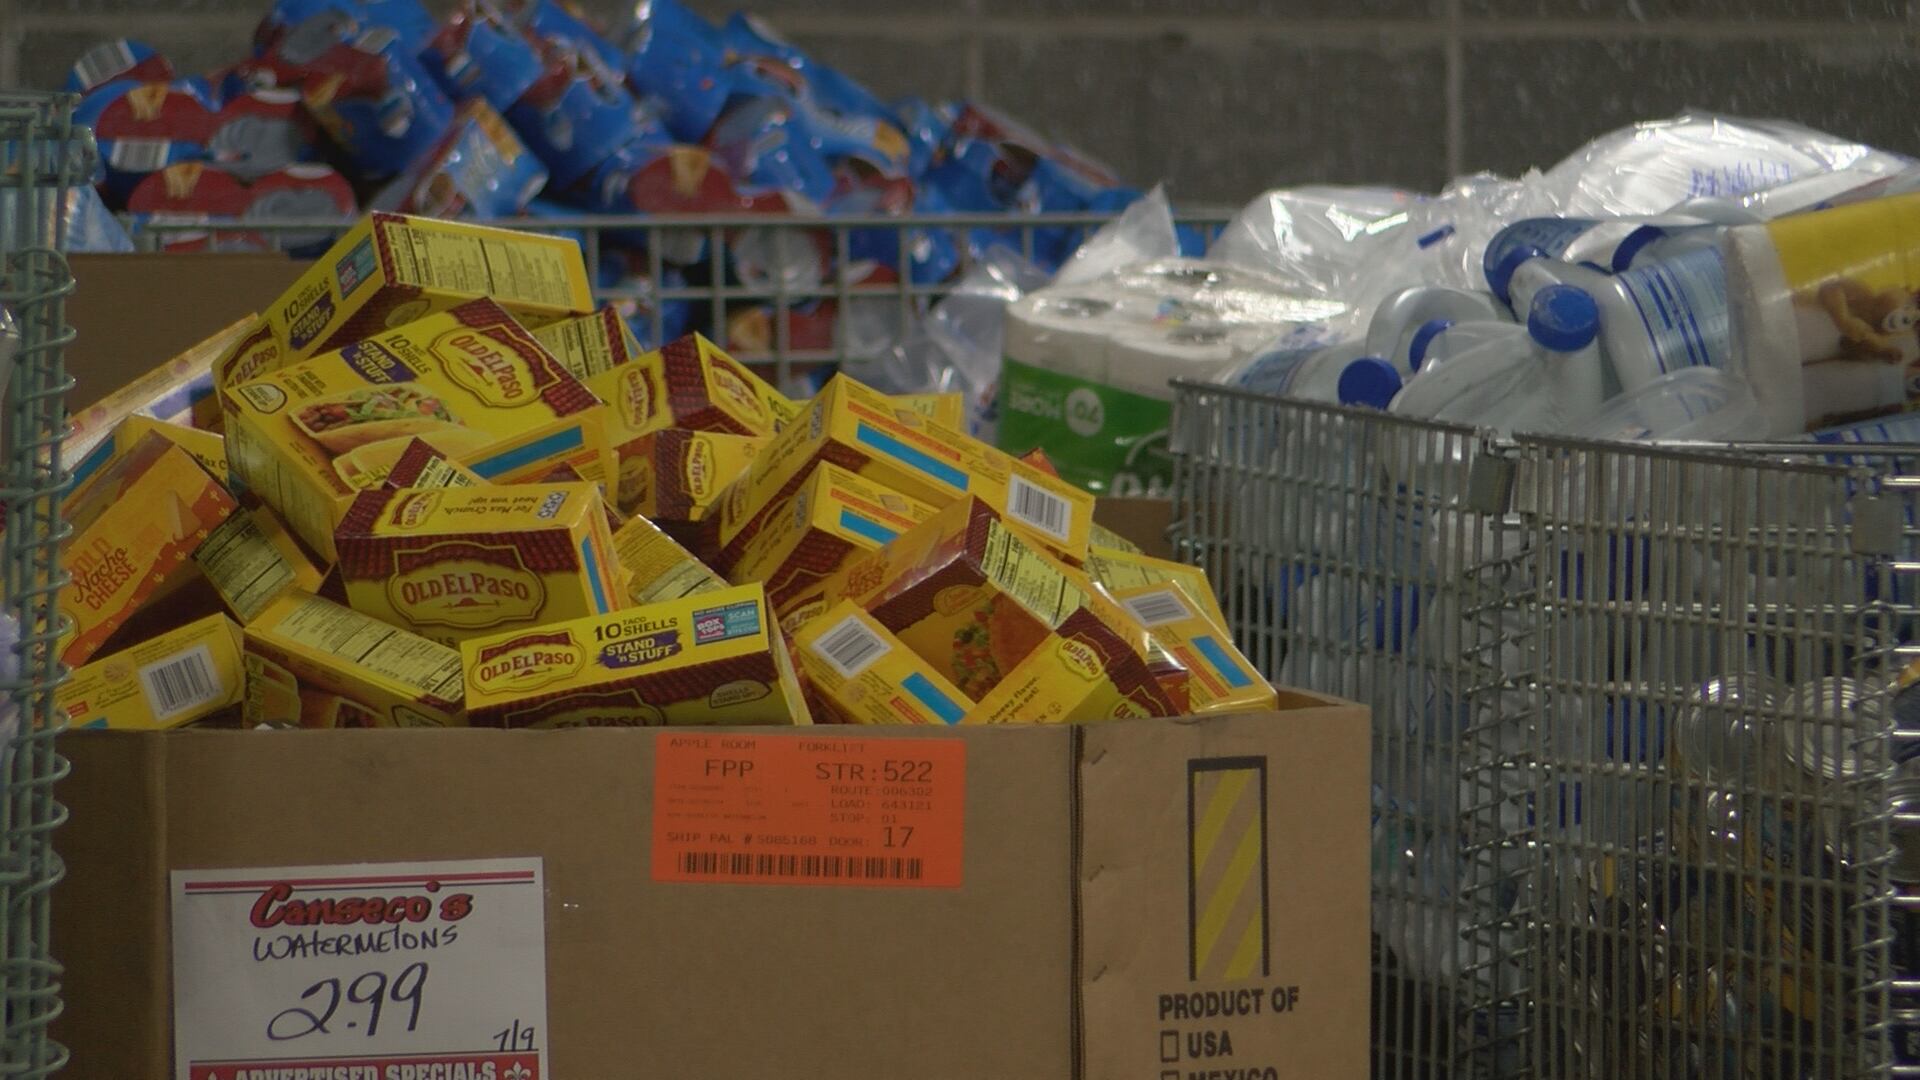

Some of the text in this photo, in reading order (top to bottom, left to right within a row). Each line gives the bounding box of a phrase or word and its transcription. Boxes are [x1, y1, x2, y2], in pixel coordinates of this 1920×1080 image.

[385, 334, 411, 350] 10
[74, 546, 128, 604] Nacho
[85, 562, 137, 611] CHEESE
[593, 617, 678, 641] 10 SHELLS
[623, 616, 647, 626] TACO
[605, 637, 656, 657] STAND
[628, 643, 674, 663] STUFF
[670, 738, 757, 750] APPLE ROOM
[704, 758, 755, 777] FPP
[667, 831, 701, 843] SHIP
[710, 832, 735, 844] PAL
[883, 826, 915, 849] 17
[250, 879, 474, 928] Canseco's
[266, 962, 429, 1041] 2.99
[1158, 985, 1300, 1021] PRODUCT OF
[1187, 1030, 1233, 1059] USA
[385, 1061, 498, 1080] SPECIALS
